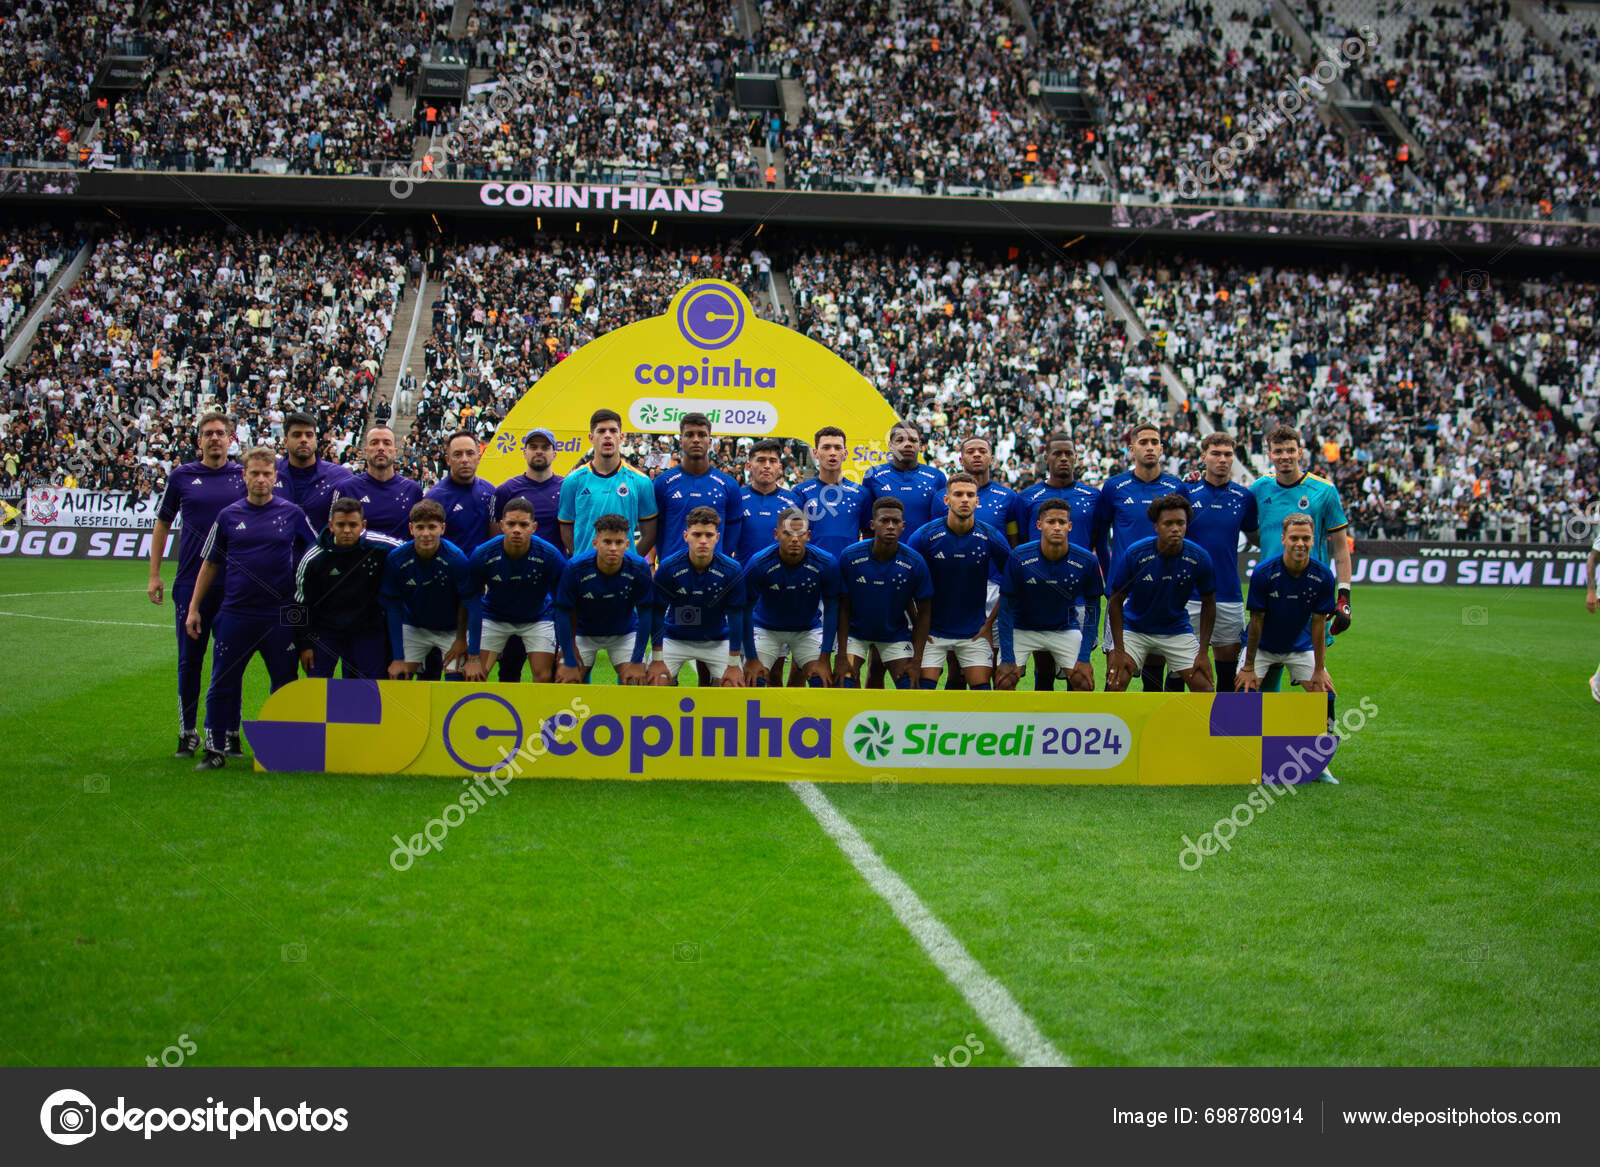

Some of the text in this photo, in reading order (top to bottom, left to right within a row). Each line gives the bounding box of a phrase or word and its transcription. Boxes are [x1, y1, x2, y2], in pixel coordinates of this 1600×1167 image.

[479, 182, 725, 213] CORINTHIANS
[634, 357, 776, 394] copinha
[662, 407, 767, 425] Sicdi 2024
[853, 446, 896, 462] Sicre
[1350, 558, 1447, 584] JOGO
[1456, 560, 1534, 585] SEM
[541, 698, 833, 774] copinha
[901, 723, 1123, 757] Sicredi 2024
